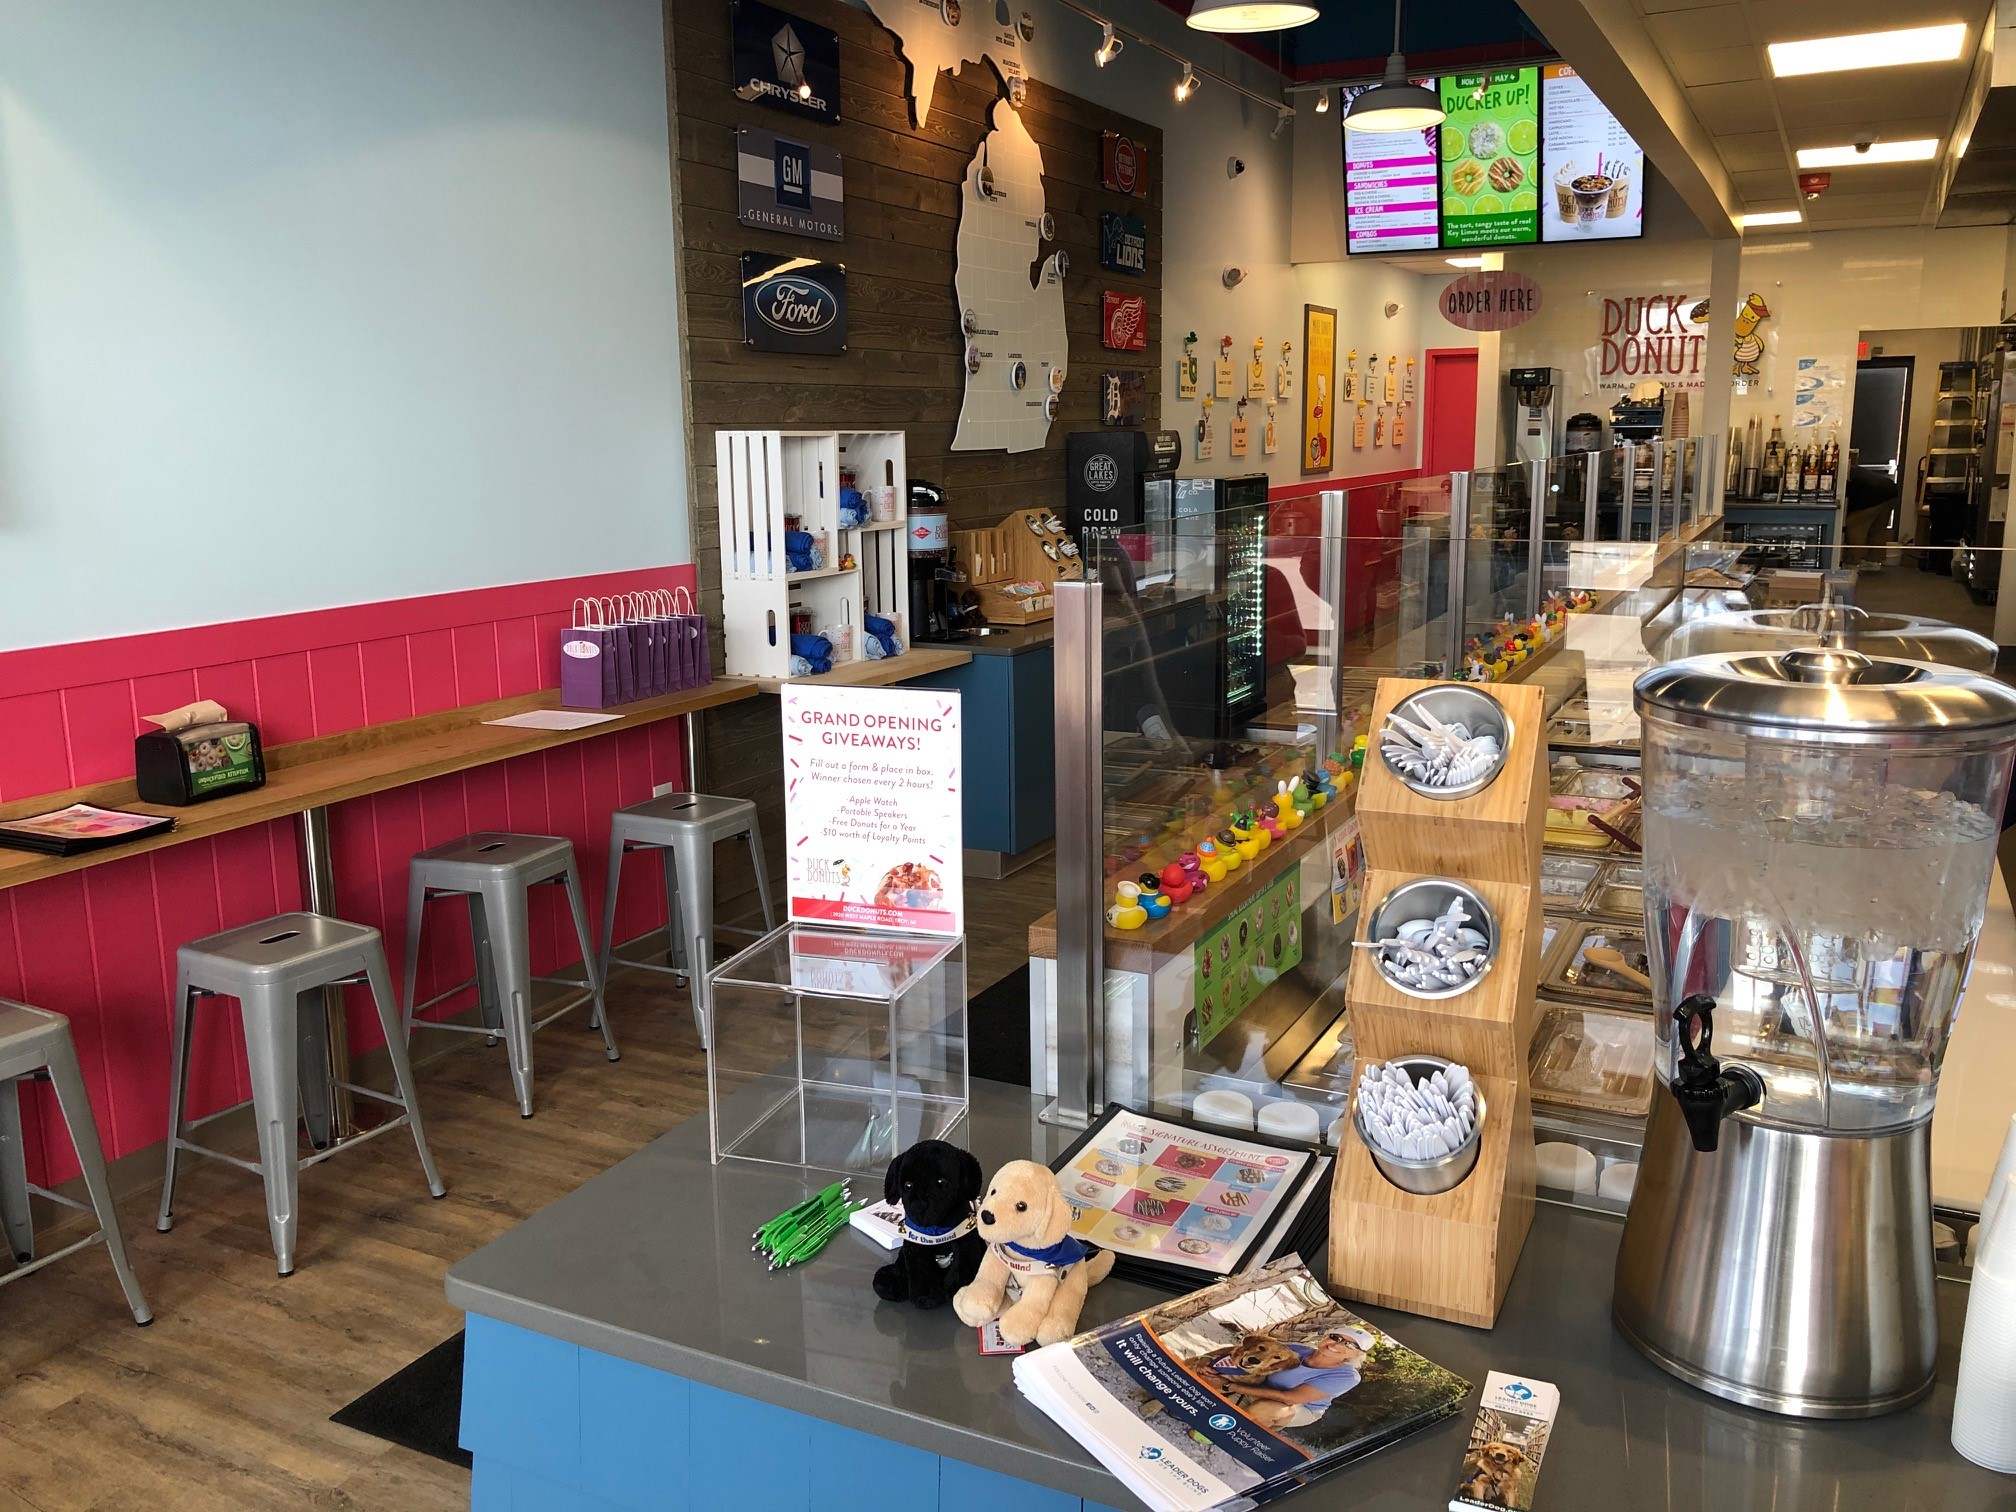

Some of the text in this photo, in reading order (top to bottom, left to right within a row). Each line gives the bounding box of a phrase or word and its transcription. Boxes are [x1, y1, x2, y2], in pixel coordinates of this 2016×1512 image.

[1461, 76, 1474, 85] NOW
[750, 78, 827, 111] CHRYSLER
[1446, 84, 1530, 114] DUCKER UP!
[783, 155, 803, 186] GM
[748, 208, 838, 236] GENERAL MOTORS
[1447, 217, 1531, 230] The tart, tangy taste of real
[1447, 229, 1459, 238] Key
[1460, 228, 1479, 236] Limes
[1480, 227, 1498, 235] meets
[1511, 226, 1531, 234] warm,
[1461, 233, 1517, 242] wonderful donuts.
[771, 283, 822, 325] Ford
[1448, 287, 1533, 314] ORDER HERE
[1601, 293, 1688, 336] DUCK
[1600, 333, 1705, 376] DONUT
[1599, 382, 1628, 390] WARM,
[1686, 380, 1705, 388] MAD
[1088, 470, 1114, 480] LAKES
[1089, 462, 1112, 471] GREAT
[1084, 508, 1119, 522] COLD
[801, 710, 942, 732] GRAND OPENING
[821, 731, 921, 751] GIVEAWAYS!
[810, 758, 823, 768] Fill
[825, 761, 839, 770] out
[849, 761, 869, 773] form
[872, 763, 879, 771] &
[881, 764, 903, 776] place
[905, 766, 914, 774] in
[916, 766, 934, 776] box.
[811, 771, 934, 789] Winner chosen every 2 hours!
[873, 796, 898, 807] Watch
[874, 809, 908, 819] Speakers
[850, 818, 878, 829] Donuts
[879, 820, 891, 831] for
[900, 822, 917, 832] Year
[839, 830, 860, 839] worth
[862, 832, 871, 843] of
[872, 832, 900, 844] Loyalty
[902, 834, 926, 845] Points
[806, 858, 830, 871] DUCK
[806, 868, 841, 884] DONUTS
[843, 905, 903, 917] DUCKDONUTS.COM
[908, 1230, 918, 1241] for
[920, 1236, 934, 1244] the
[1129, 1336, 1141, 1351] only
[1139, 1349, 1159, 1370] change
[1157, 1367, 1182, 1389] someone
[1180, 1387, 1197, 1402] else's
[1135, 1332, 1154, 1354] Raising
[1155, 1356, 1173, 1374] Future
[1171, 1370, 1191, 1390] Leader
[1188, 1384, 1202, 1398] Dog
[1115, 1339, 1200, 1417] It will change yours.
[1226, 1430, 1276, 1463] Puppy Raiser
[1236, 1427, 1272, 1452] Volunteer
[1159, 1457, 1209, 1494] LEADER DOGS
